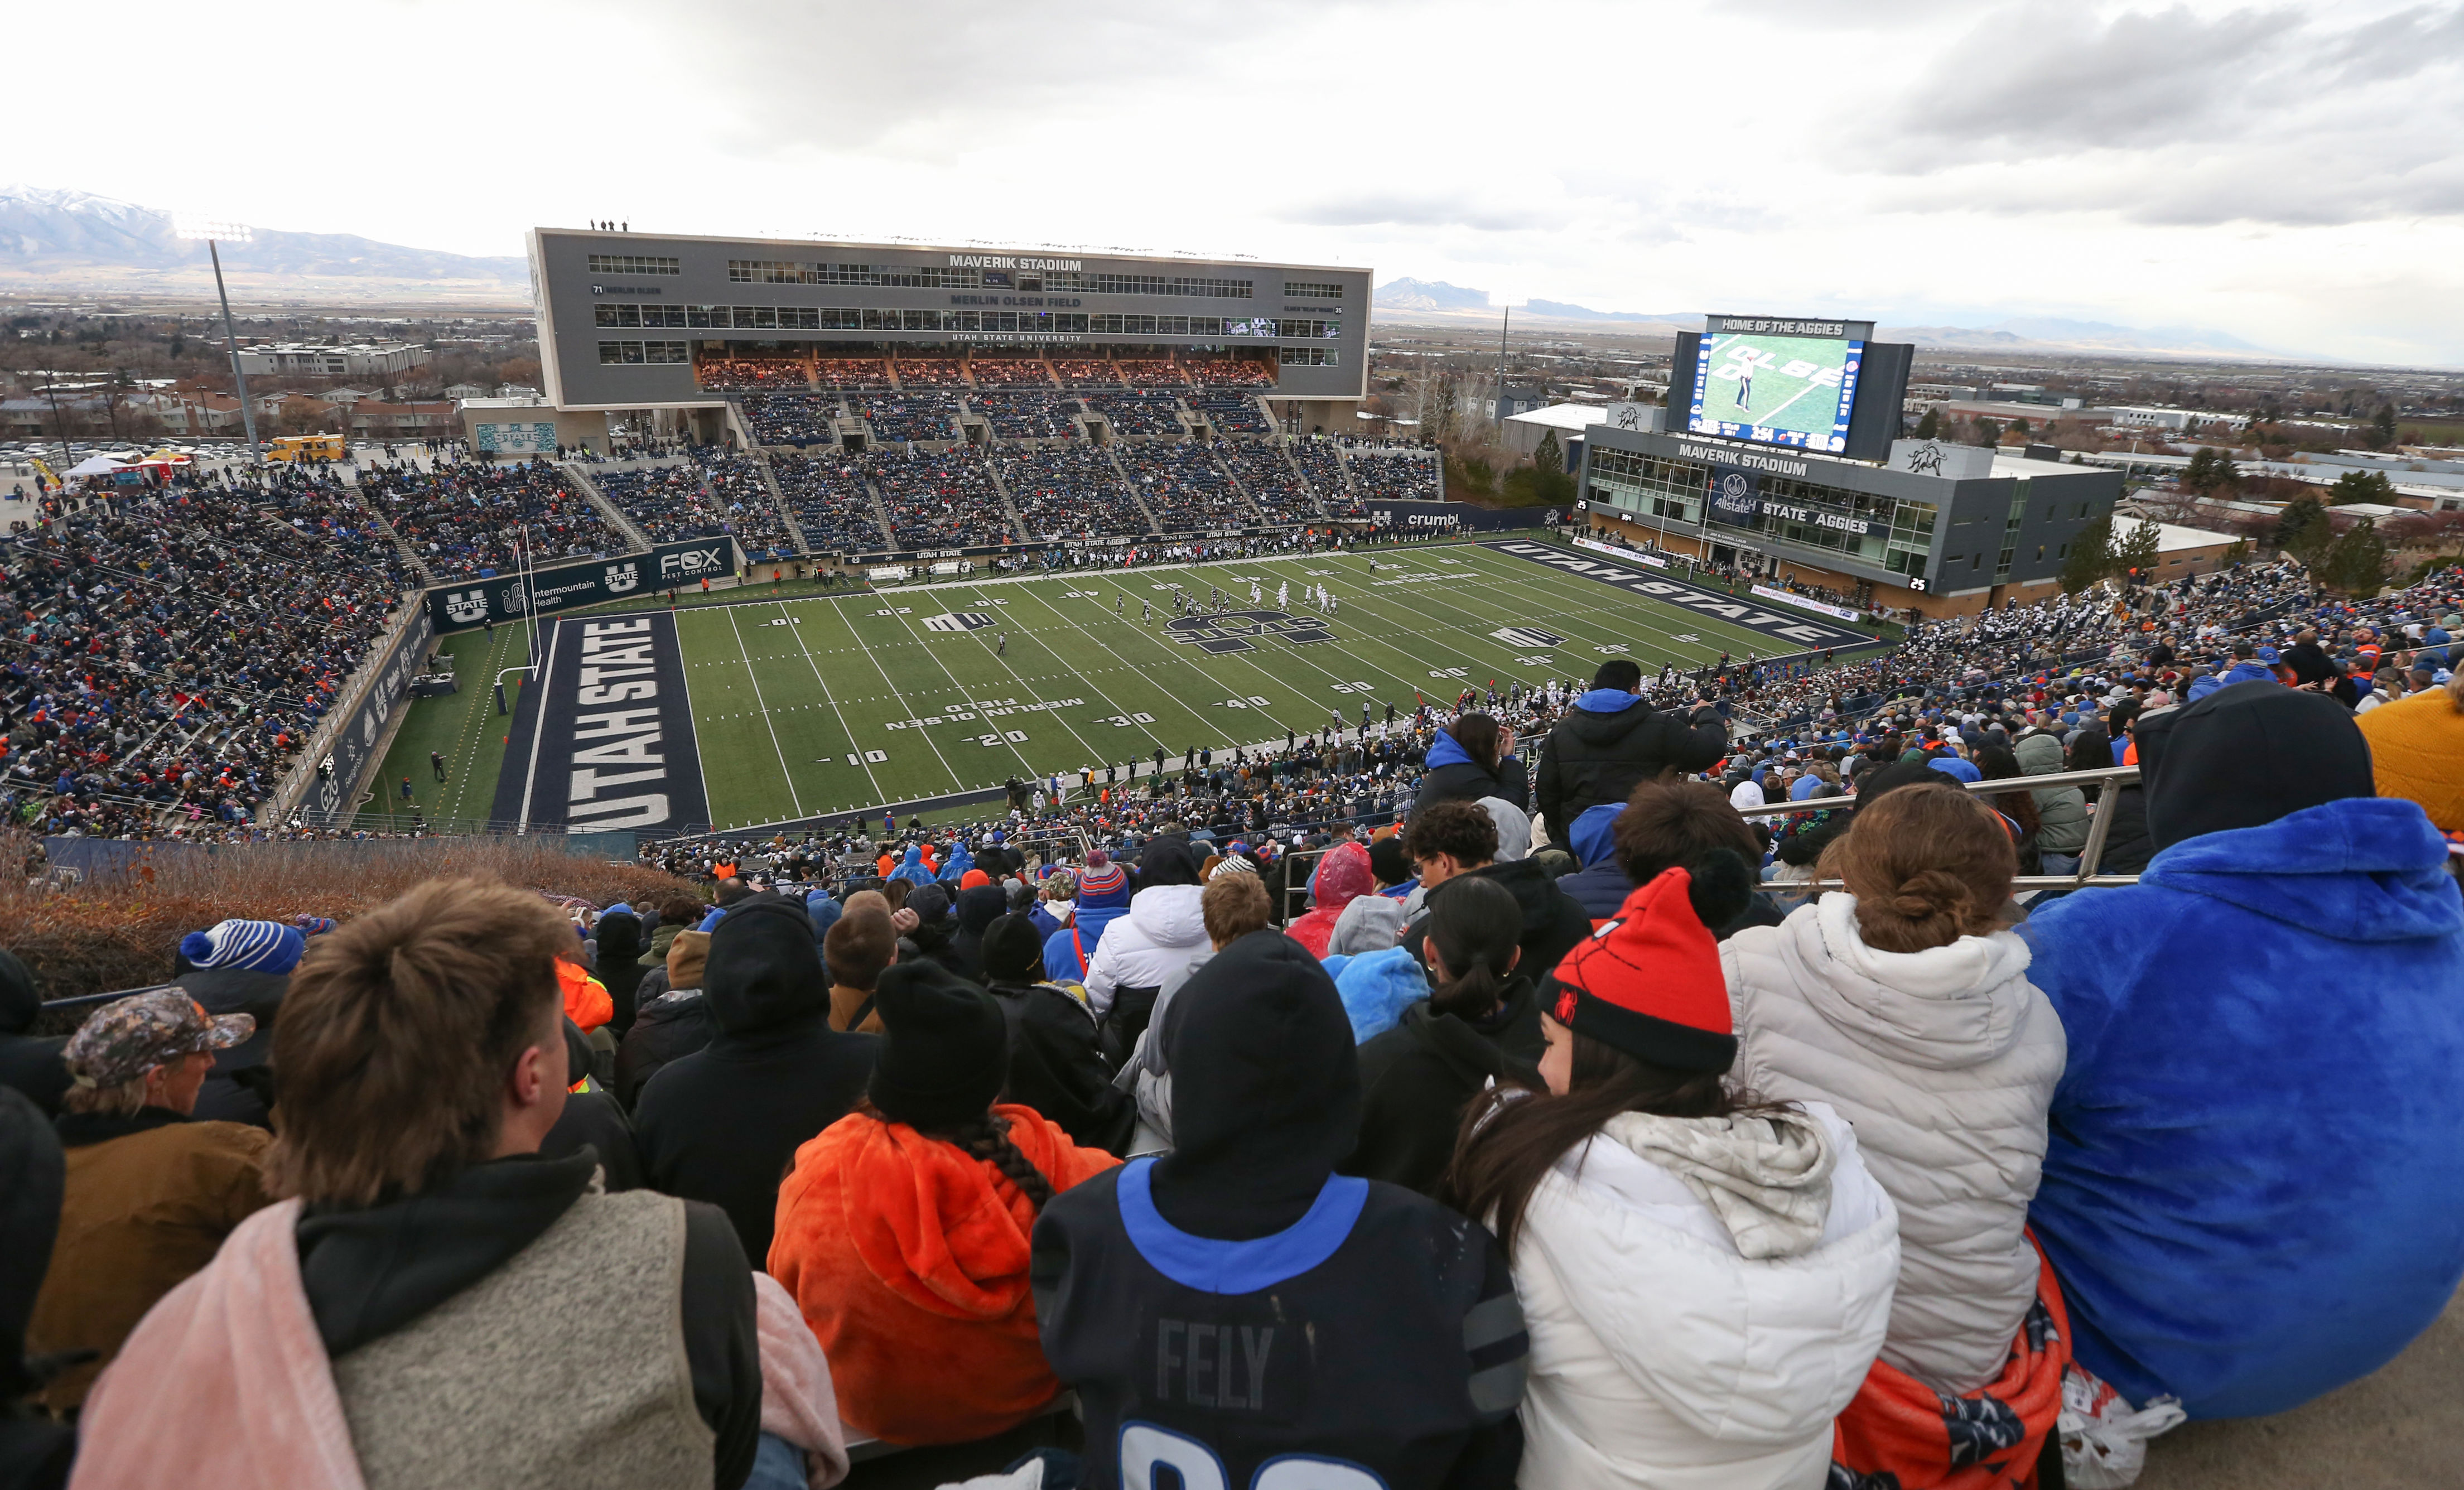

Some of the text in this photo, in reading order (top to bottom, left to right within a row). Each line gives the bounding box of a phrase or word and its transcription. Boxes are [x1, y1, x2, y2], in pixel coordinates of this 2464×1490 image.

[949, 255, 1082, 272] MAVERIK STADIUM
[951, 295, 1082, 307] MERLIN OLSEN FIELD
[1722, 319, 1844, 336] HOME OF THE AGGIES
[494, 431, 540, 443] STATE
[1679, 443, 1808, 476] MAVERIK STADIUM
[1577, 499, 1586, 509] 25
[1714, 498, 1750, 513] Allstate
[1408, 513, 1459, 526] crumbl
[1763, 502, 1809, 522] STATE
[1815, 513, 1868, 534] AGGIES
[660, 547, 722, 574] FOX
[605, 571, 639, 585] STATE
[685, 565, 722, 576] CONTROL
[533, 581, 595, 597] ntermountain
[1150, 582, 1184, 591] 50
[1910, 578, 1925, 590] 25
[1067, 590, 1100, 599] 40
[1499, 544, 1842, 642] UTAH STATE
[446, 598, 488, 615] STATE
[974, 598, 1010, 607] 30
[876, 606, 912, 616] 20
[770, 617, 801, 626] 10
[1159, 616, 1330, 645] STATE
[1670, 634, 1700, 643] 10
[1593, 643, 1627, 654] 20
[577, 618, 659, 706] STATE
[1513, 654, 1549, 666] 30
[1428, 667, 1469, 679] 40
[1330, 681, 1376, 693] 50
[944, 697, 1018, 713] FIELD
[1225, 696, 1272, 710] 40
[885, 697, 1085, 731] MERLIN OLSEN
[1107, 711, 1157, 727] 30
[977, 730, 1029, 748] 20
[846, 749, 889, 766] 10
[566, 707, 670, 834] UTAH
[321, 771, 338, 811] G2G
[1156, 1318, 1275, 1411] FELY
